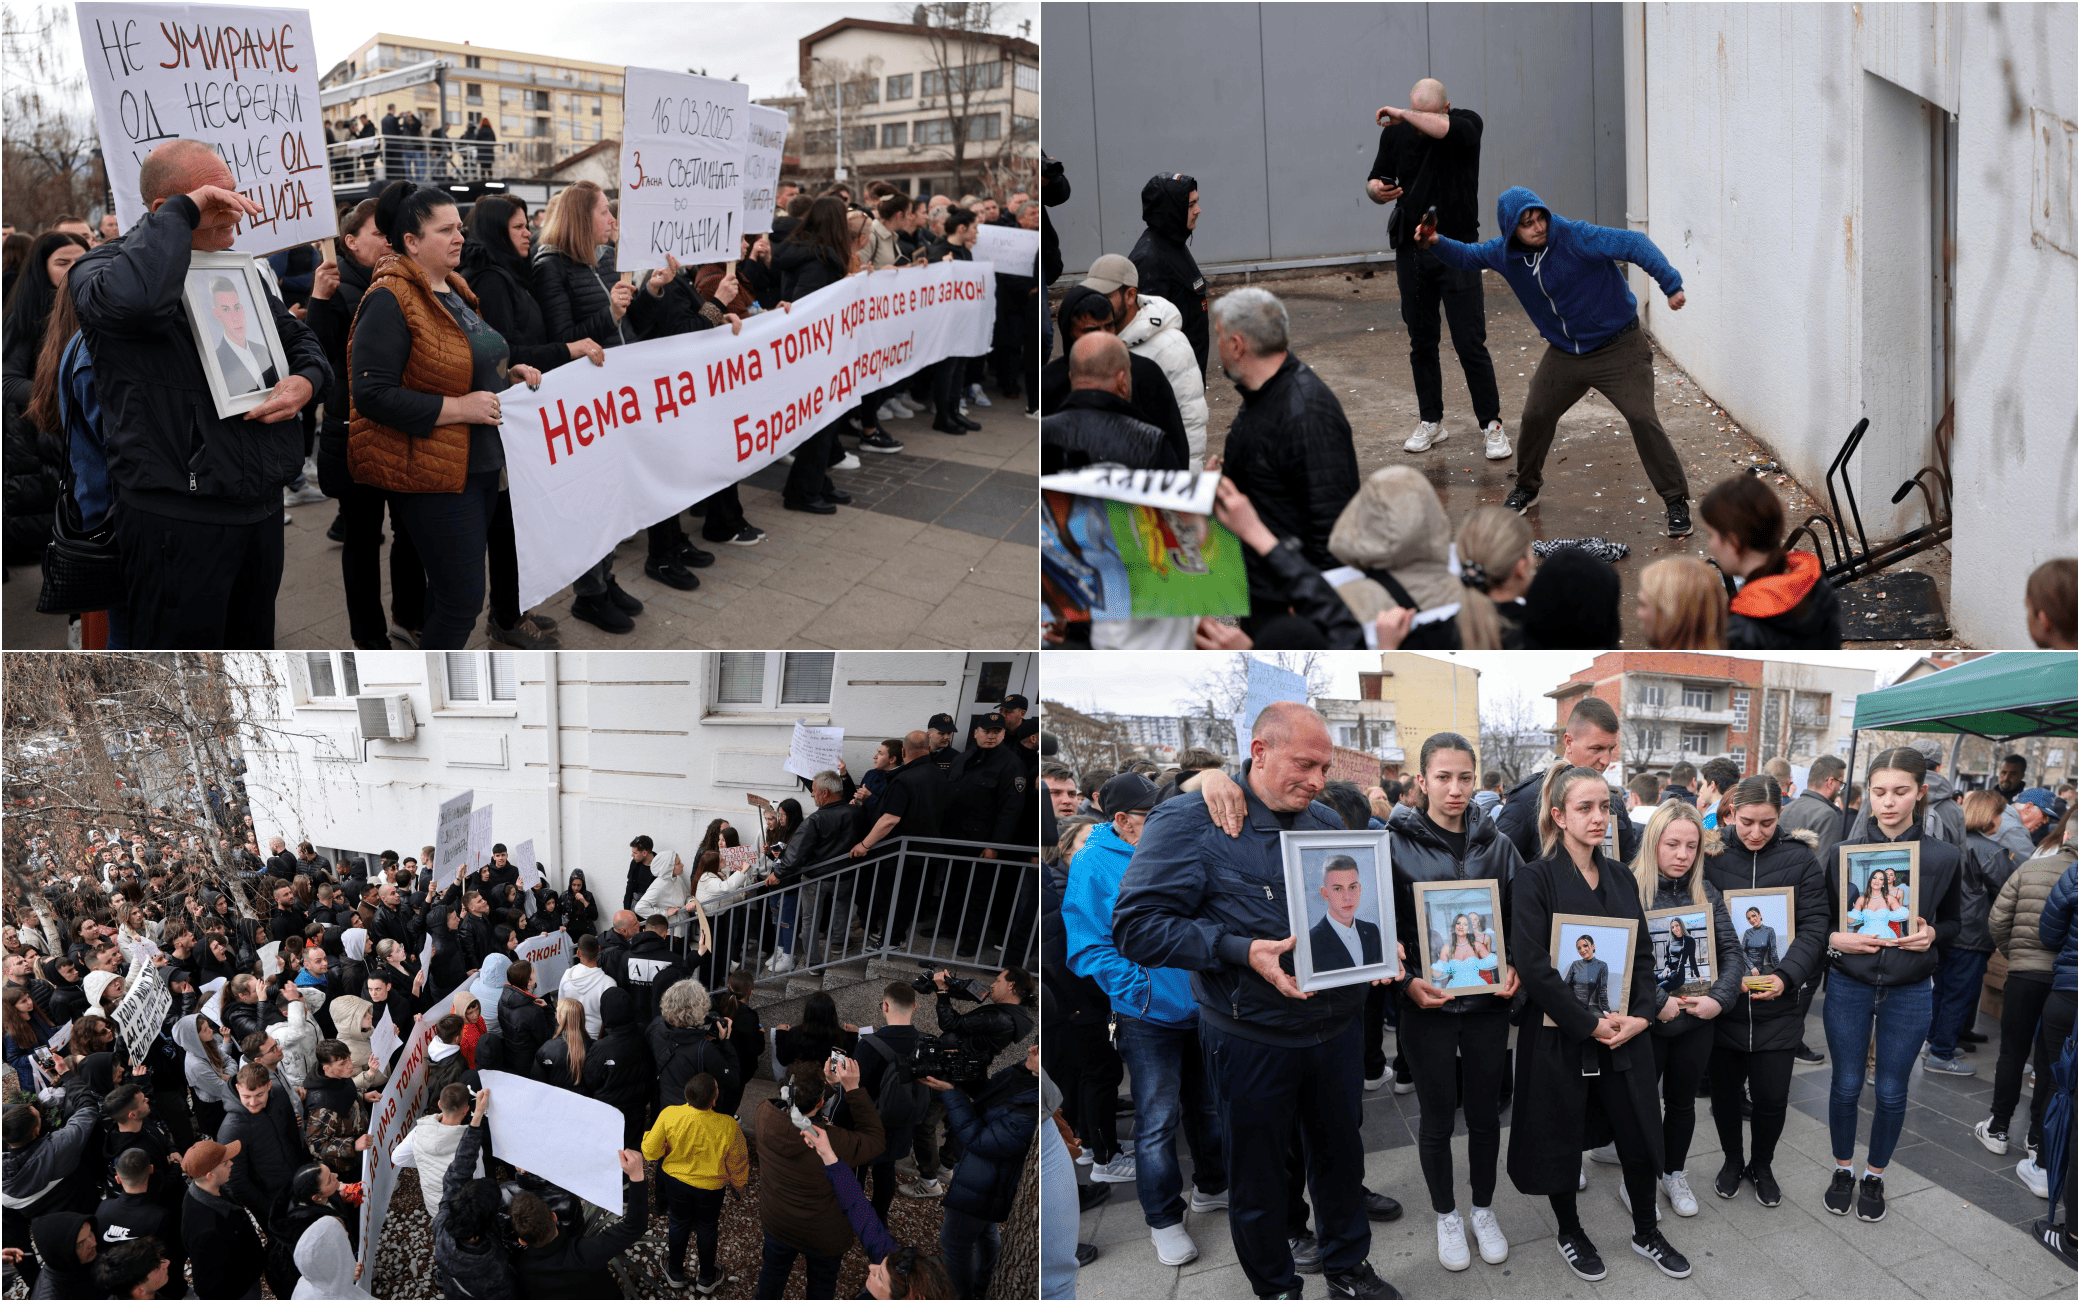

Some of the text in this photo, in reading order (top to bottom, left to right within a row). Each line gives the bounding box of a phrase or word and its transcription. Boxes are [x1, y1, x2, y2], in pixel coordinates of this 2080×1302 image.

[96, 19, 299, 82] НЕ УМИРАМЕ
[120, 90, 179, 143] ОД
[281, 131, 323, 175] ОД
[667, 158, 739, 189] СВЕТЛИНАТА
[539, 275, 986, 466] Нема да има толку крв ако се е по закон!
[733, 386, 824, 463] Бараме
[377, 1097, 397, 1148] има
[396, 1037, 423, 1099] толку
[107, 1224, 131, 1238] NIKE
